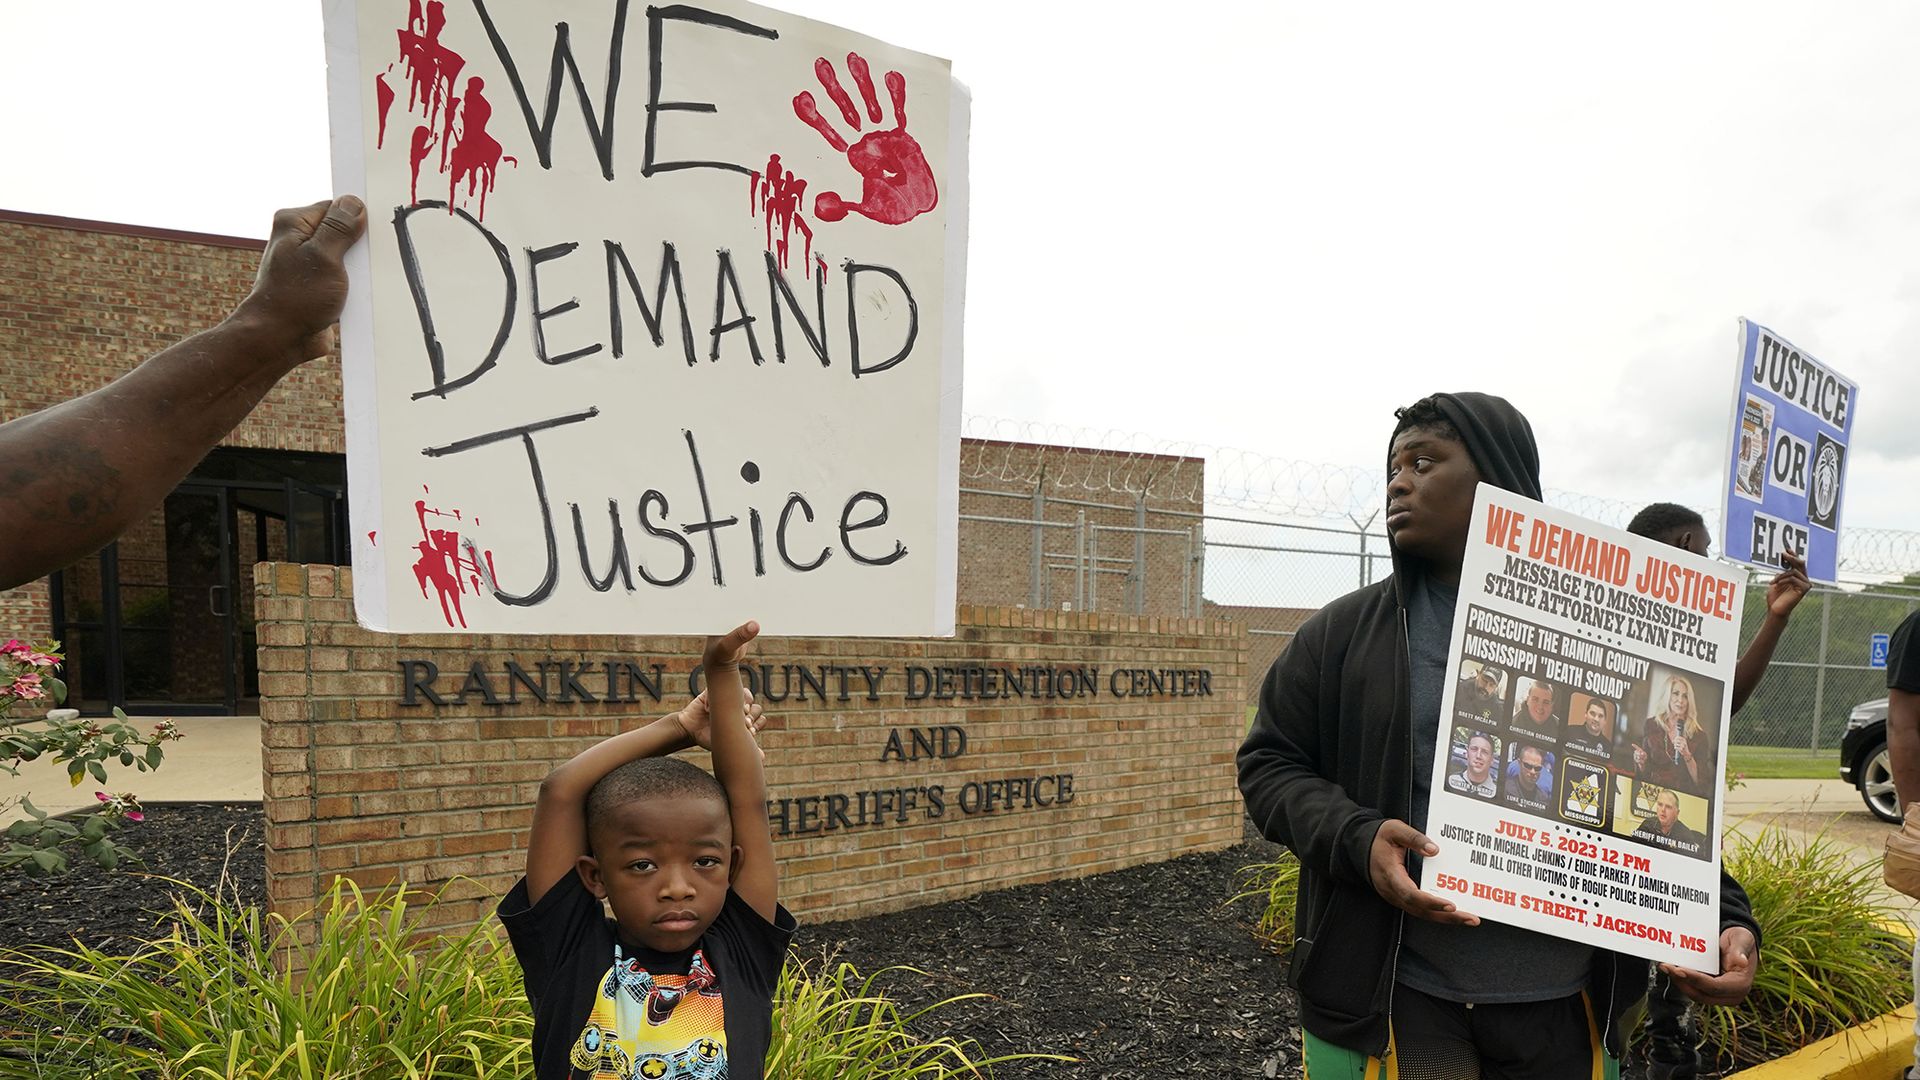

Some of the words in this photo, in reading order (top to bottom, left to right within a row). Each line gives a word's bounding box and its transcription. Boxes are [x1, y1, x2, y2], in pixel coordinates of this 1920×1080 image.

[474, 0, 779, 181] WE
[392, 200, 918, 400] DEMAND
[1753, 334, 1849, 430] JUSTICE
[1773, 435, 1807, 491] OR
[421, 406, 908, 608] Justice
[1485, 503, 1525, 554] WE
[1528, 518, 1631, 587] DEMAND
[1635, 556, 1736, 621] JUSTICE!
[1752, 515, 1807, 570] ELSE
[1484, 573, 1535, 609] STATE
[1538, 590, 1626, 634] ATTORNEY
[1626, 613, 1669, 648] LYNN
[1670, 625, 1718, 664] FITCH
[1503, 555, 1581, 598] MESSAGE
[1584, 581, 1604, 605] TO
[1606, 587, 1704, 636] MISSISSIPPI
[1464, 633, 1537, 674] MISSISSIPPI
[1540, 656, 1584, 688] "DEATH
[1585, 669, 1631, 700] SQUAD"
[1468, 607, 1534, 648] PROSECUTE
[1537, 627, 1560, 654] THE
[1561, 634, 1604, 667] RANKIN
[1606, 648, 1650, 681] COUNTY
[397, 660, 666, 707] RANKIN
[904, 665, 1099, 701] DETENTION
[1110, 667, 1214, 698] CENTER
[879, 725, 968, 762] AND
[766, 784, 945, 836] HERIFF'S
[959, 773, 1075, 815] OFFICE
[1564, 810, 1600, 825] MISSISSIPPI
[1440, 823, 1474, 844] JUSTICE
[1476, 832, 1492, 849] FOR
[1493, 837, 1530, 860] MICHAEL
[1532, 848, 1566, 869] JENKINS
[1574, 858, 1597, 877] EDDIE
[1599, 865, 1630, 885] PARKER
[1638, 876, 1670, 896] DAMIEN
[1671, 884, 1710, 906] CAMERON
[1495, 820, 1537, 842] JULY
[1557, 836, 1597, 859] 2023
[1601, 847, 1619, 865] 12
[1622, 853, 1651, 873] PM
[1631, 829, 1655, 841] SHERIFF
[1656, 834, 1677, 847] BRYAN
[1677, 840, 1699, 852] BAILEY
[1436, 873, 1468, 894] 550
[1472, 882, 1517, 907] HIGH
[1520, 894, 1589, 927] STREET,
[1593, 913, 1676, 948] JACKSON,
[1680, 934, 1707, 953] MS
[1470, 849, 1487, 867] AND
[1489, 855, 1504, 871] ALL
[1506, 859, 1532, 879] OTHER
[1534, 866, 1568, 888] VICTIMS
[1570, 875, 1580, 891] OF
[1582, 878, 1608, 898] ROGUE
[1609, 885, 1637, 905] POLICE
[1639, 892, 1680, 916] BRUTALITY
